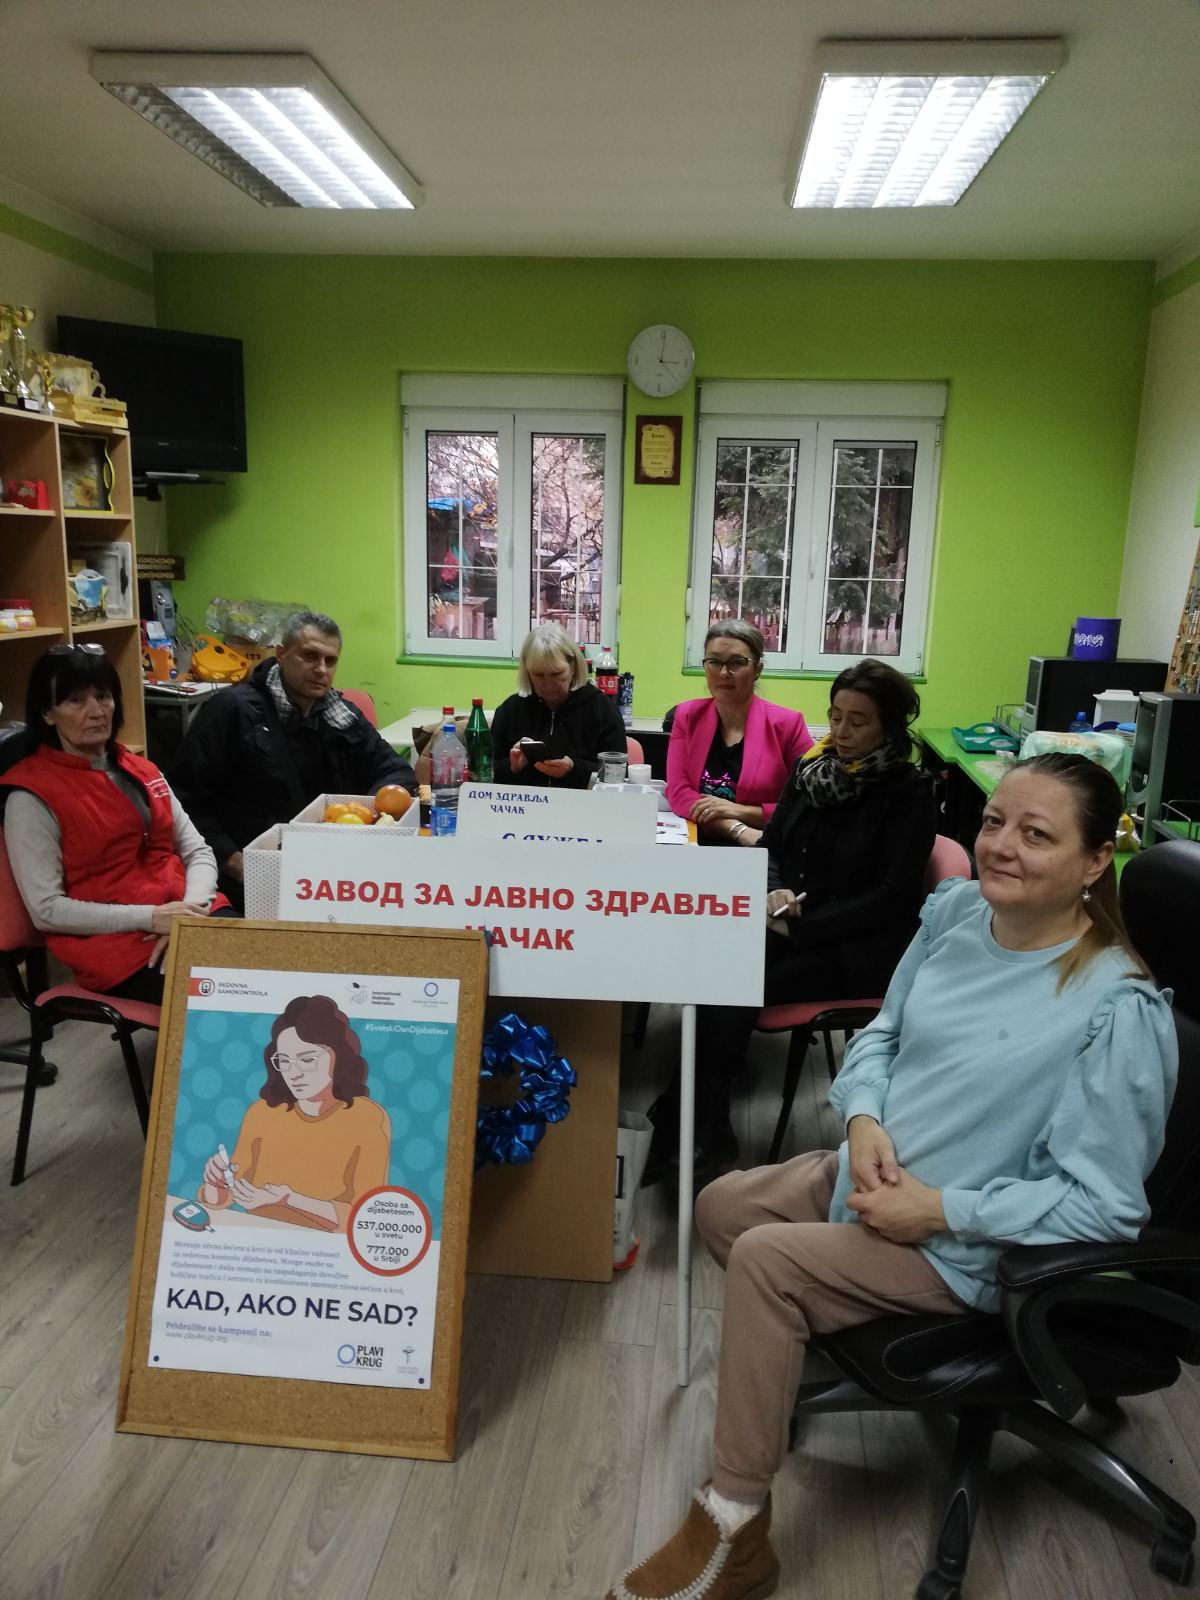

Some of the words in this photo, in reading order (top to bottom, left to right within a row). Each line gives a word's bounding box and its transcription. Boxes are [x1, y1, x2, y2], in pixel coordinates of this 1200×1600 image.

[468, 790, 492, 800] ДОМ
[495, 792, 549, 803] ЗДРАВЉА
[490, 804, 526, 814] ЧАЧАК
[295, 878, 404, 908] ЗАВОД
[414, 882, 455, 906] ЗА
[465, 885, 575, 911] ЈАВНО
[585, 889, 751, 917] ЗДРАВЉЕ
[365, 1023, 449, 1036] #SvetskiDanDijabetesa
[374, 1200, 399, 1208] Osoba
[367, 1206, 415, 1216] dijabetesom
[357, 1220, 422, 1234] 537.000.000
[382, 1232, 403, 1240] svetu
[366, 1244, 409, 1256] 777.000
[166, 1288, 230, 1316] KAD,
[237, 1293, 297, 1316] AKO
[304, 1298, 341, 1321] NE
[348, 1301, 418, 1327] SAD?
[208, 1326, 217, 1334] se
[218, 1325, 258, 1337] kampanji
[357, 1345, 384, 1358] PLAVI
[356, 1356, 384, 1368] KRUG
